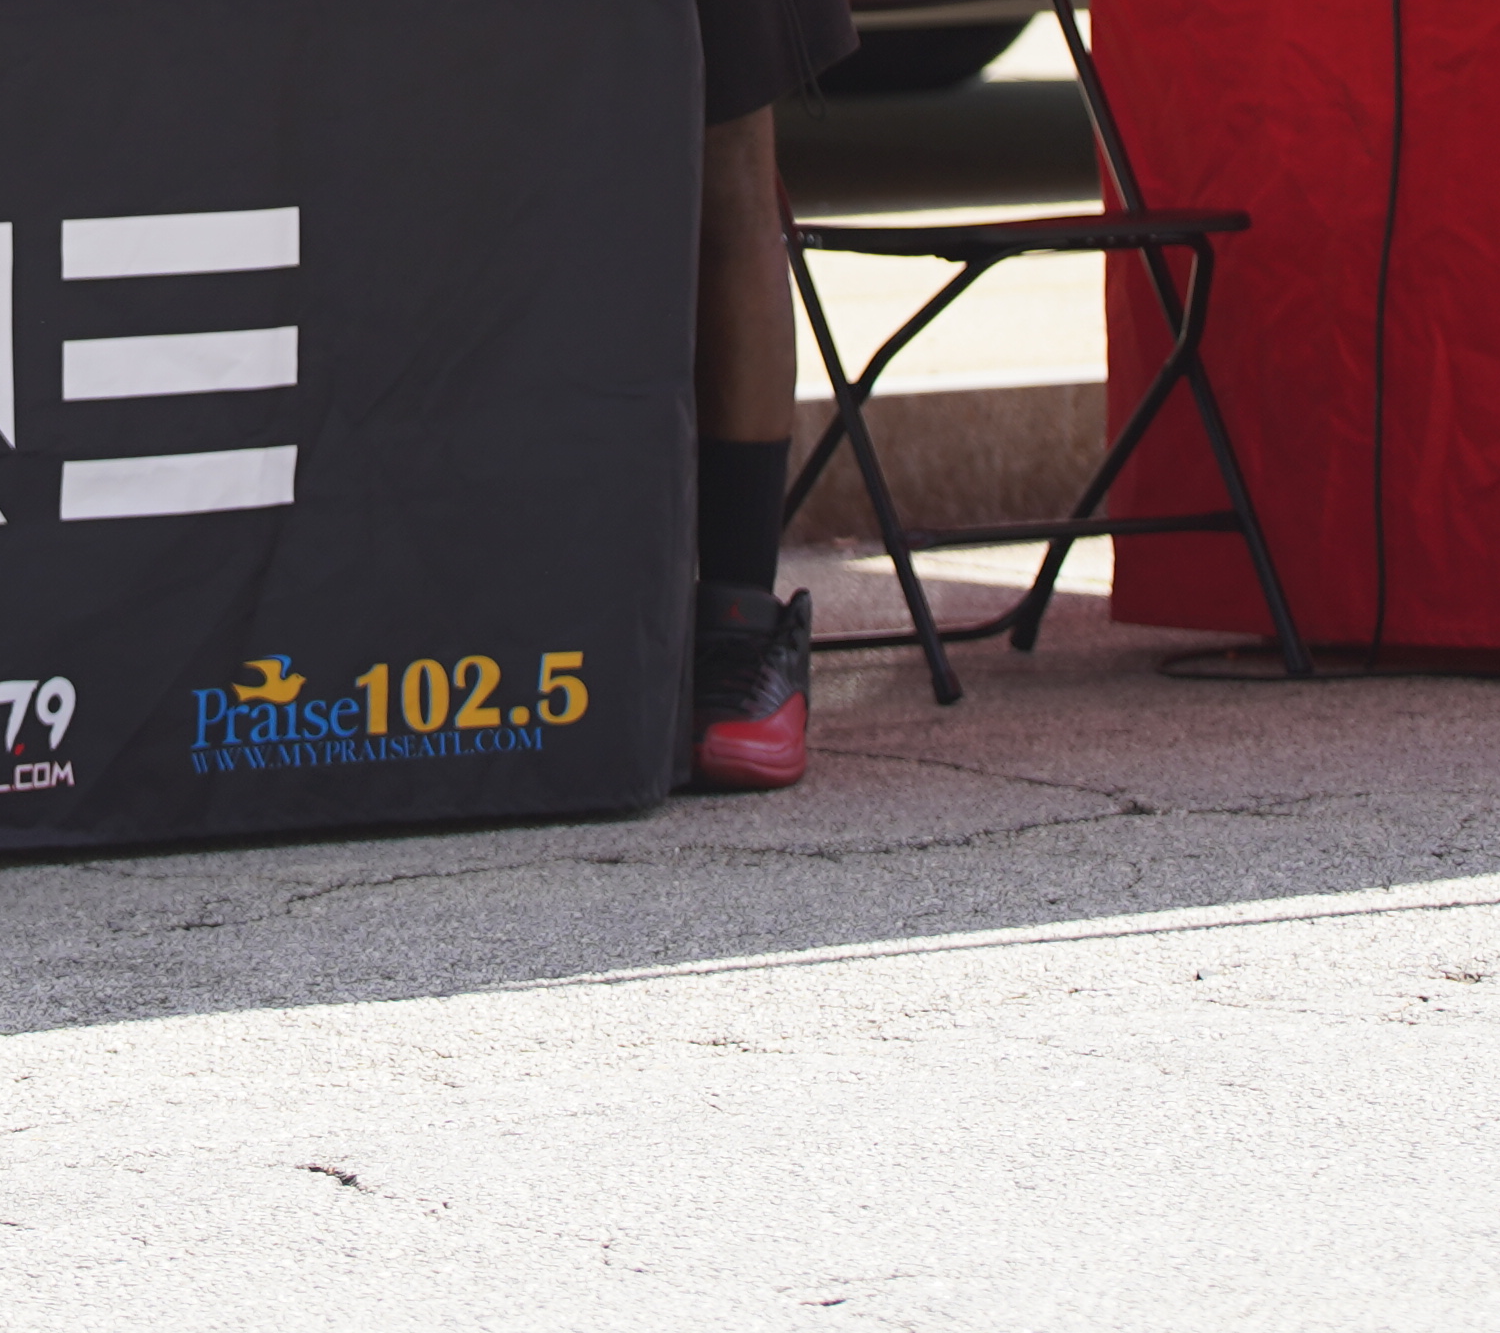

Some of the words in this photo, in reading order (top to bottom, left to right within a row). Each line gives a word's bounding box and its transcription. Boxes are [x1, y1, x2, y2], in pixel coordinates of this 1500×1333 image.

[193, 686, 359, 750] Praise
[355, 651, 590, 736] 102.5
[191, 726, 545, 775] WWW.MYPRAISEATL.COM
